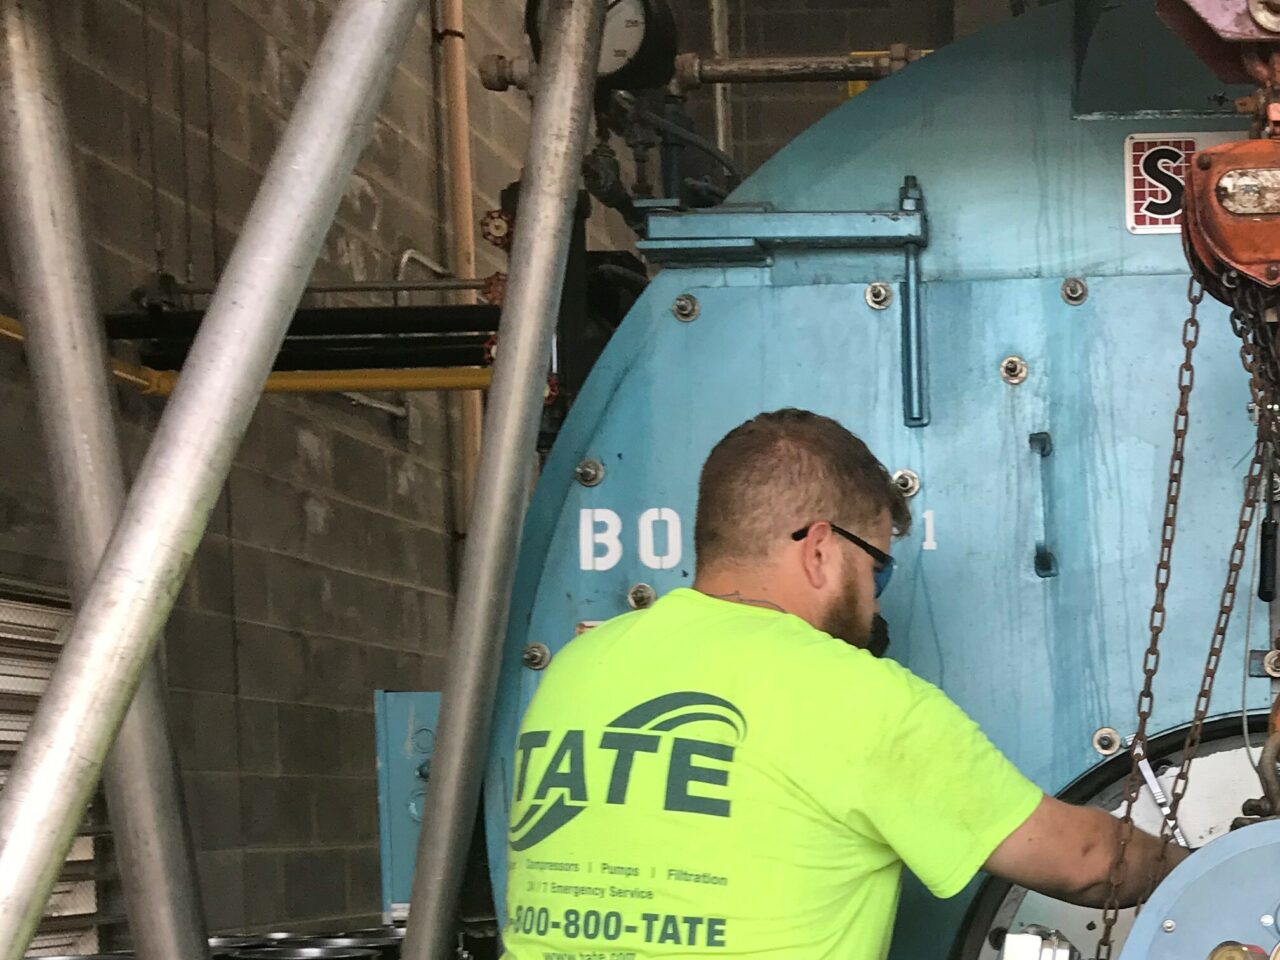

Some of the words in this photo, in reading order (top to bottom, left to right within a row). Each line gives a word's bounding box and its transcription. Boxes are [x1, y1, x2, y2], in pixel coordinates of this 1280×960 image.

[516, 729, 736, 818] TATE
[551, 881, 605, 898] Emergency
[609, 885, 654, 900] Service
[601, 862, 640, 878] Pumps
[667, 868, 728, 887] Filtration
[509, 905, 727, 948] -800-800-TATE
